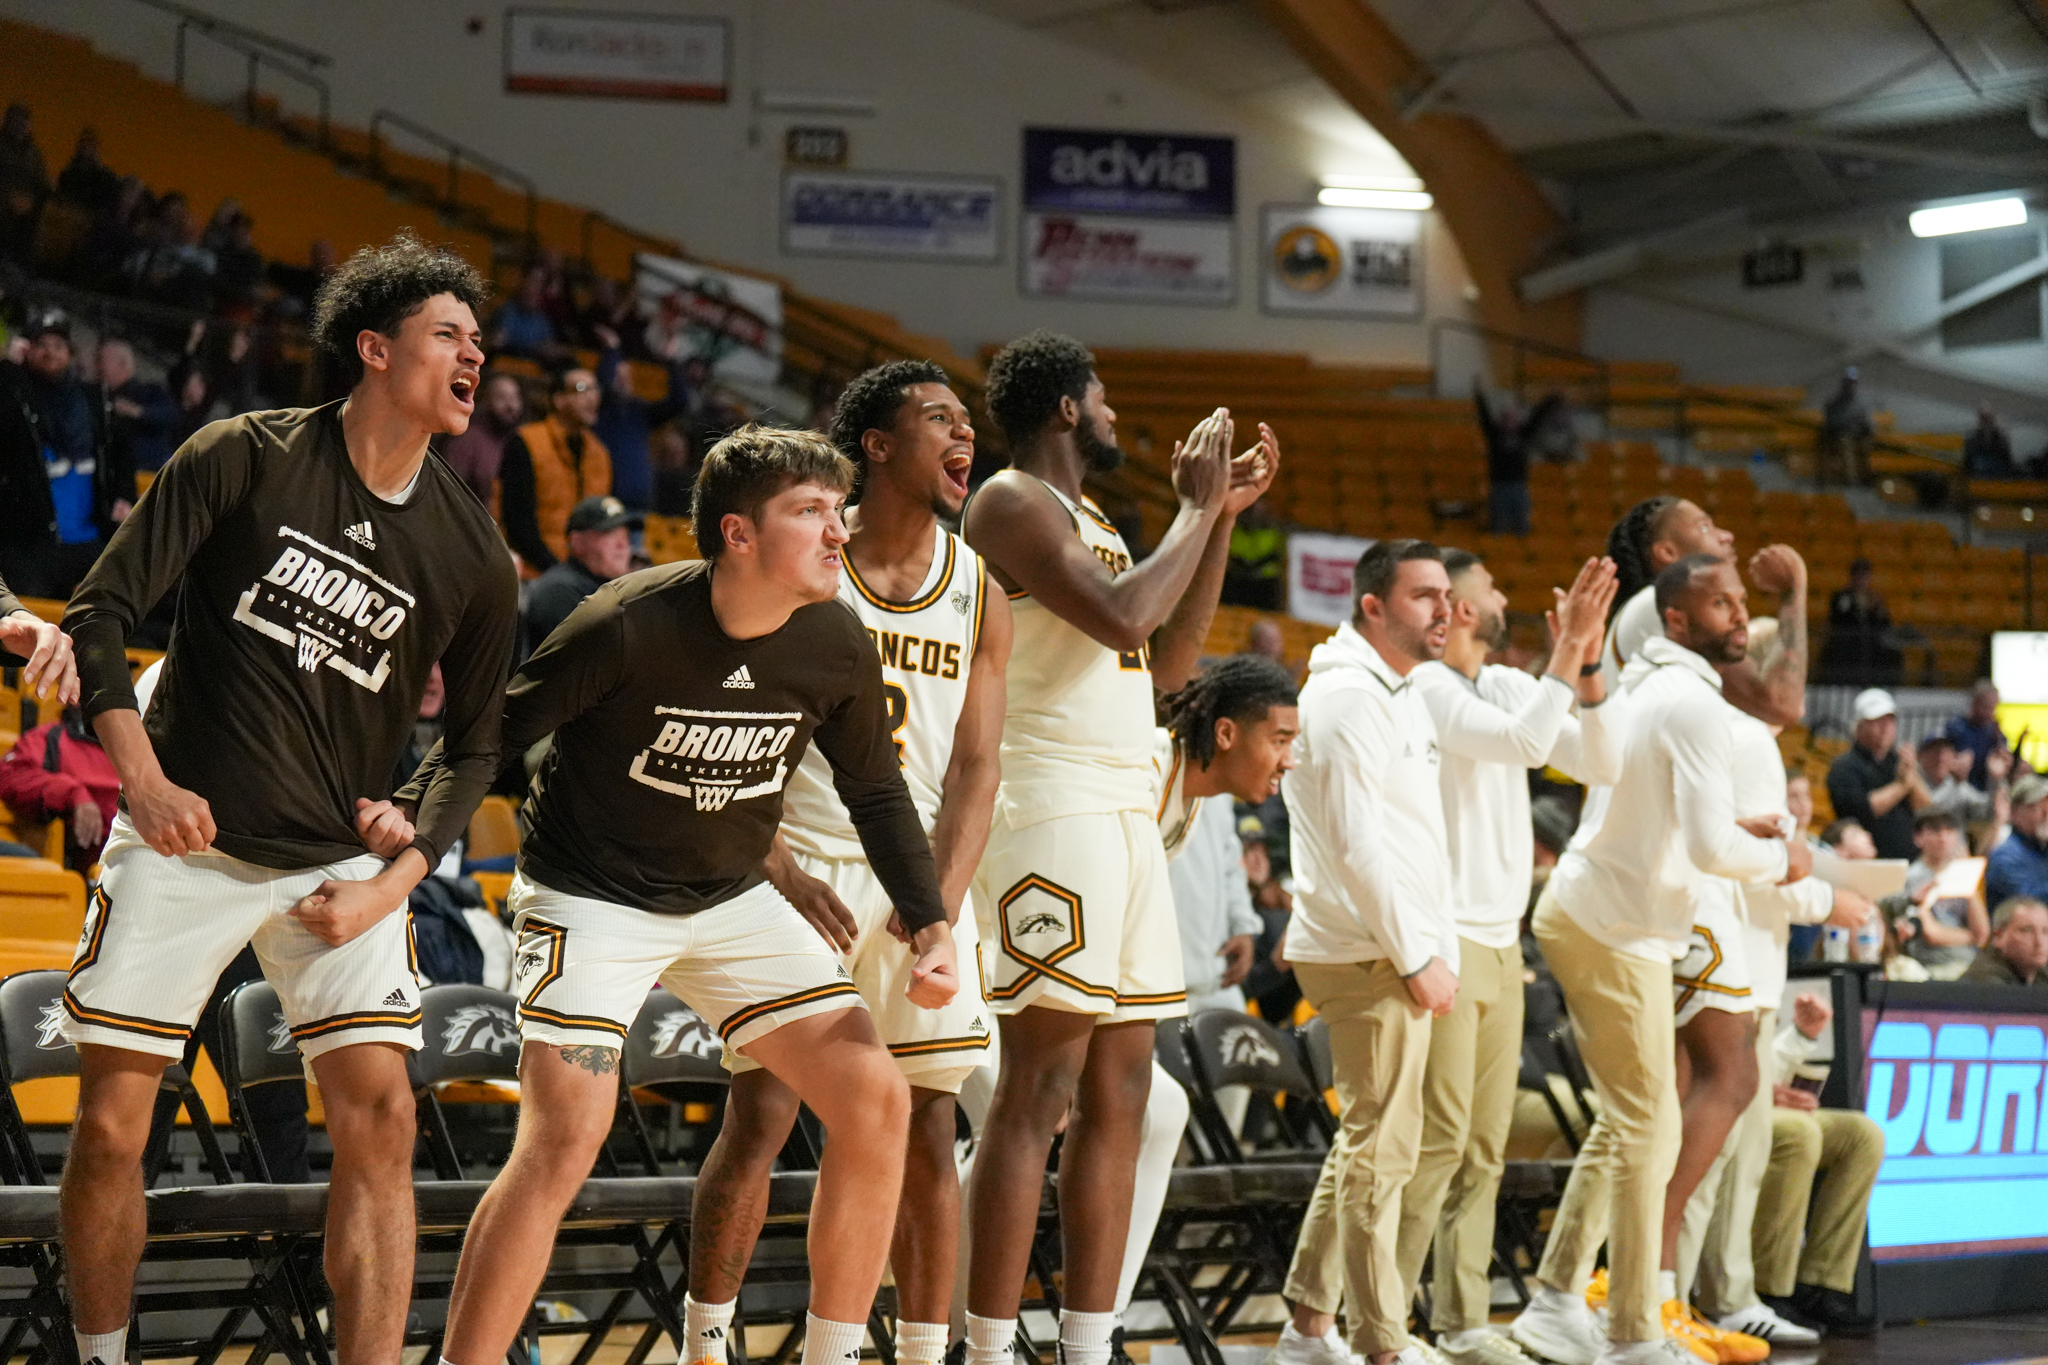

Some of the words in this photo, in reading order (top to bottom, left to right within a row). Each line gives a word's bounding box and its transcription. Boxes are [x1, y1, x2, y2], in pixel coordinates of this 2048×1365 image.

[1050, 140, 1208, 191] advia
[344, 528, 377, 551] adidas
[262, 546, 406, 641] BRONCO
[267, 593, 373, 654] BASKETBALL
[722, 679, 755, 689] adidas
[649, 720, 796, 762] BRONCO
[657, 758, 771, 776] BASKETBALL
[382, 999, 410, 1008] adidas
